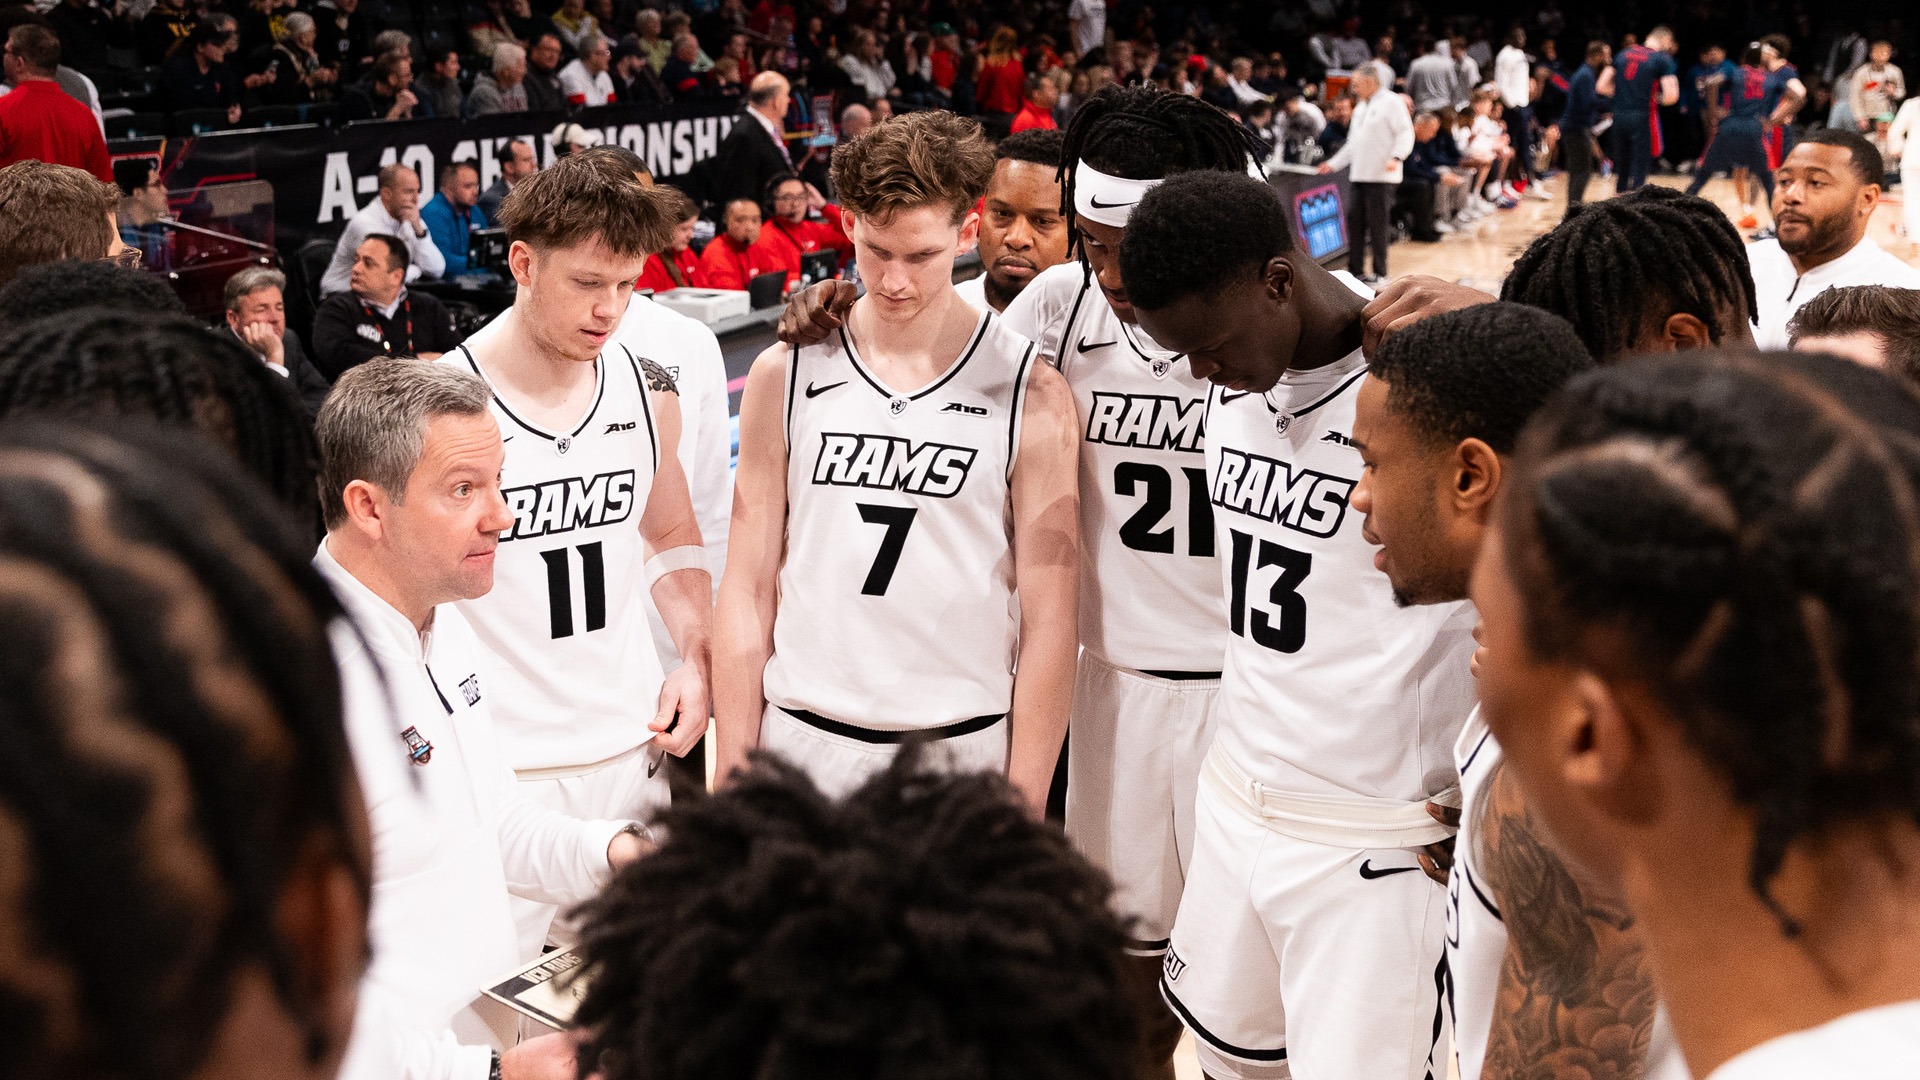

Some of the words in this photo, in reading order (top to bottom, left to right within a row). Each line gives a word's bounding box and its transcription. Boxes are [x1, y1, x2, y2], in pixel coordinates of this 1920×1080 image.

[603, 421, 637, 435] A10
[940, 402, 988, 416] A10
[1085, 391, 1205, 453] RAM
[1320, 430, 1357, 448] A1
[812, 432, 979, 498] RAMS
[1212, 446, 1359, 539] RAMS
[498, 469, 635, 542] RAMS
[1114, 461, 1215, 558] 21
[855, 502, 918, 596] 7
[539, 541, 606, 640] 11
[1229, 527, 1312, 654] 13
